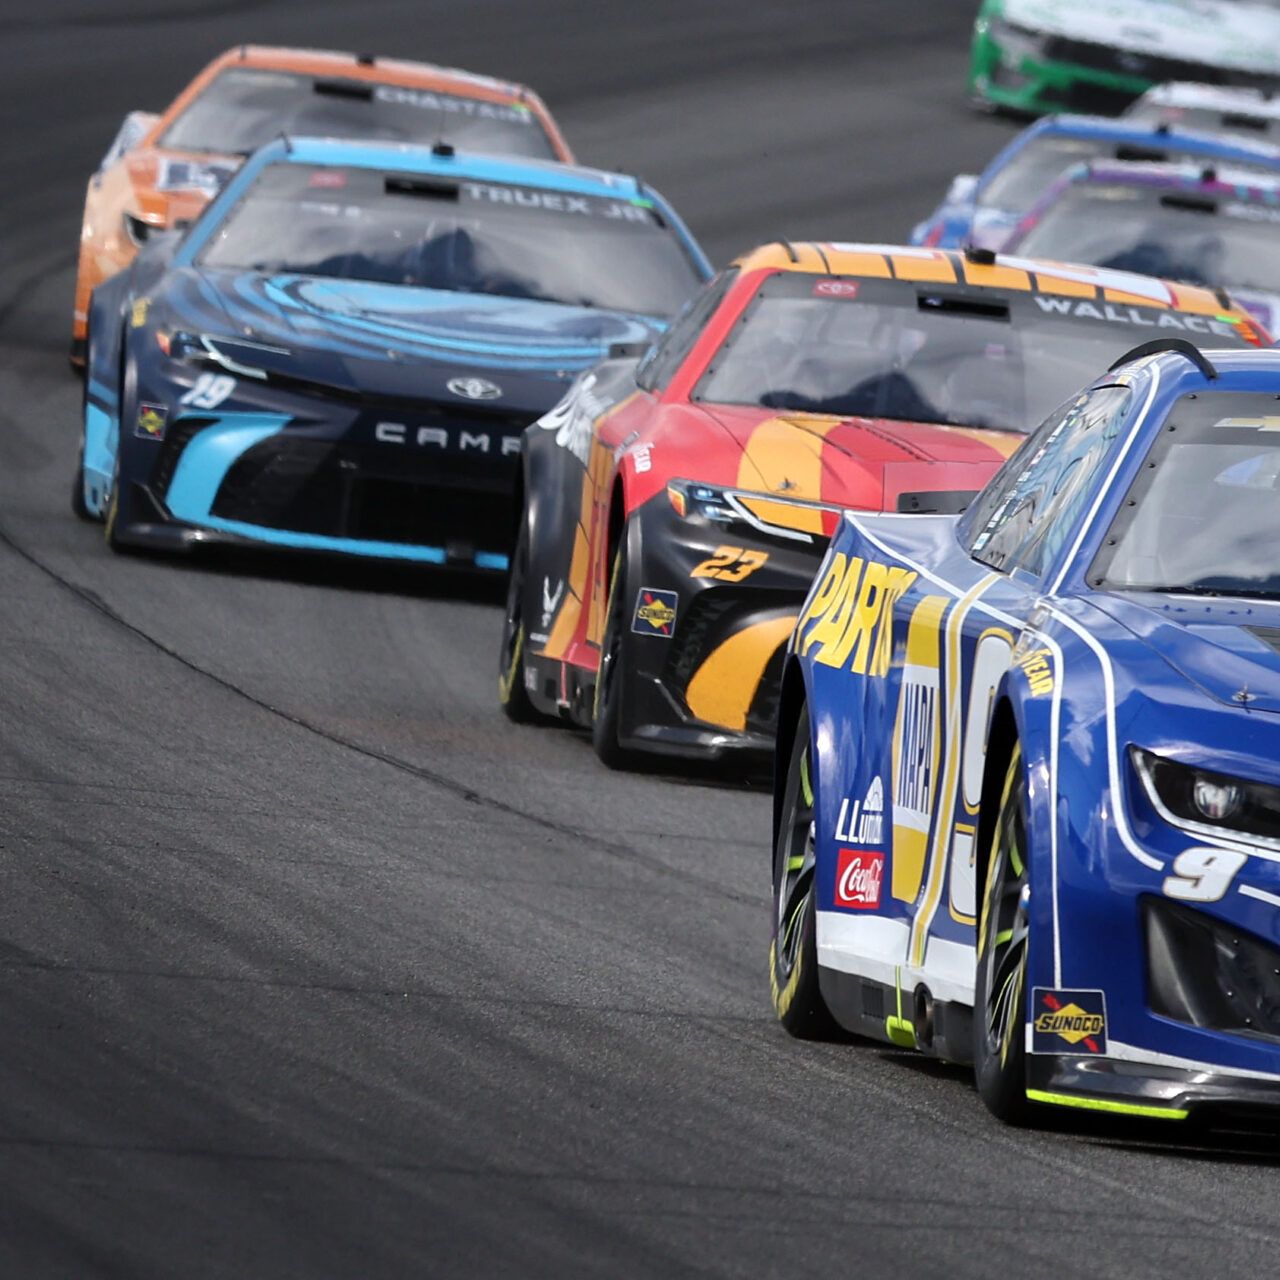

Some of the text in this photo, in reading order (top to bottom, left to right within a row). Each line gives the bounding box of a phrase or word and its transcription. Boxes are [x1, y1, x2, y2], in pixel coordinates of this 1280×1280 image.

[462, 182, 592, 216] TRUEX
[1034, 295, 1237, 339] WALLACE
[180, 371, 238, 410] 19
[689, 544, 770, 584] 23
[1162, 846, 1249, 903] 9
[1038, 1015, 1101, 1032] SUNOCO
